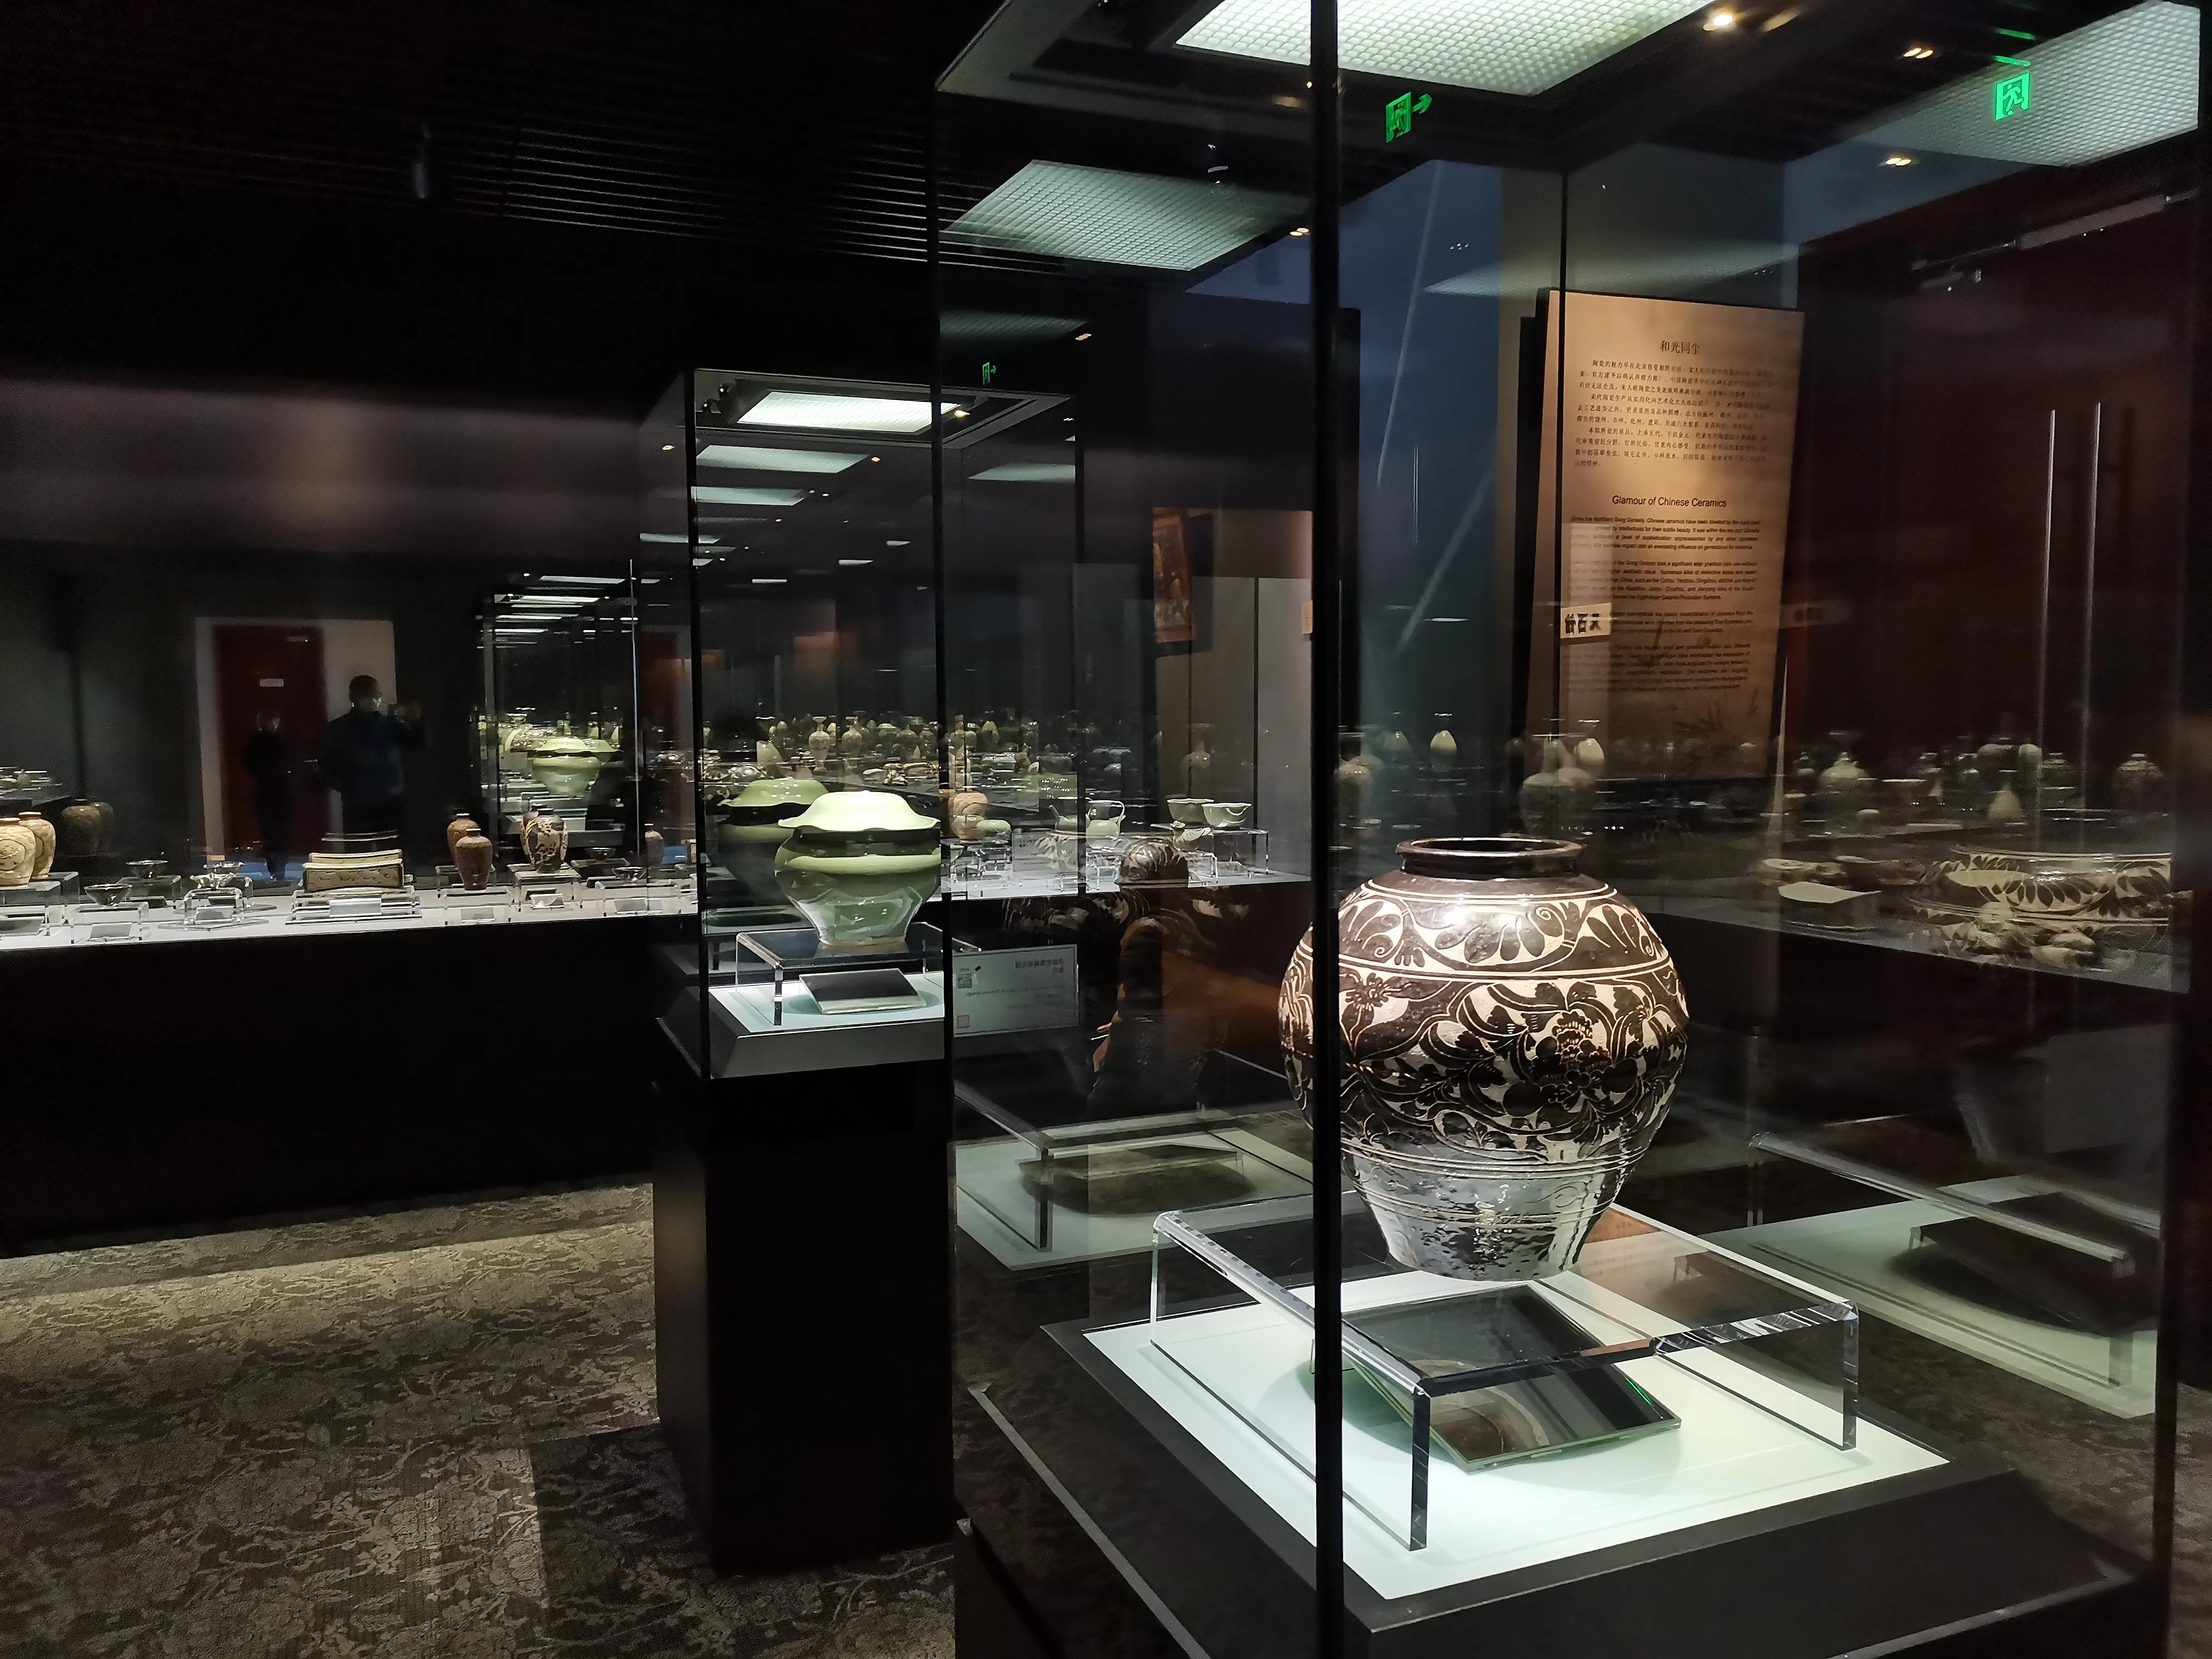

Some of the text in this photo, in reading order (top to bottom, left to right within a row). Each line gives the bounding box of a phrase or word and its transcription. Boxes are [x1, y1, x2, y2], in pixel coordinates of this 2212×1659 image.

[1660, 339, 1700, 354] 和光同尘
[1612, 495, 1728, 507] Glamour of Chinese Ceramics
